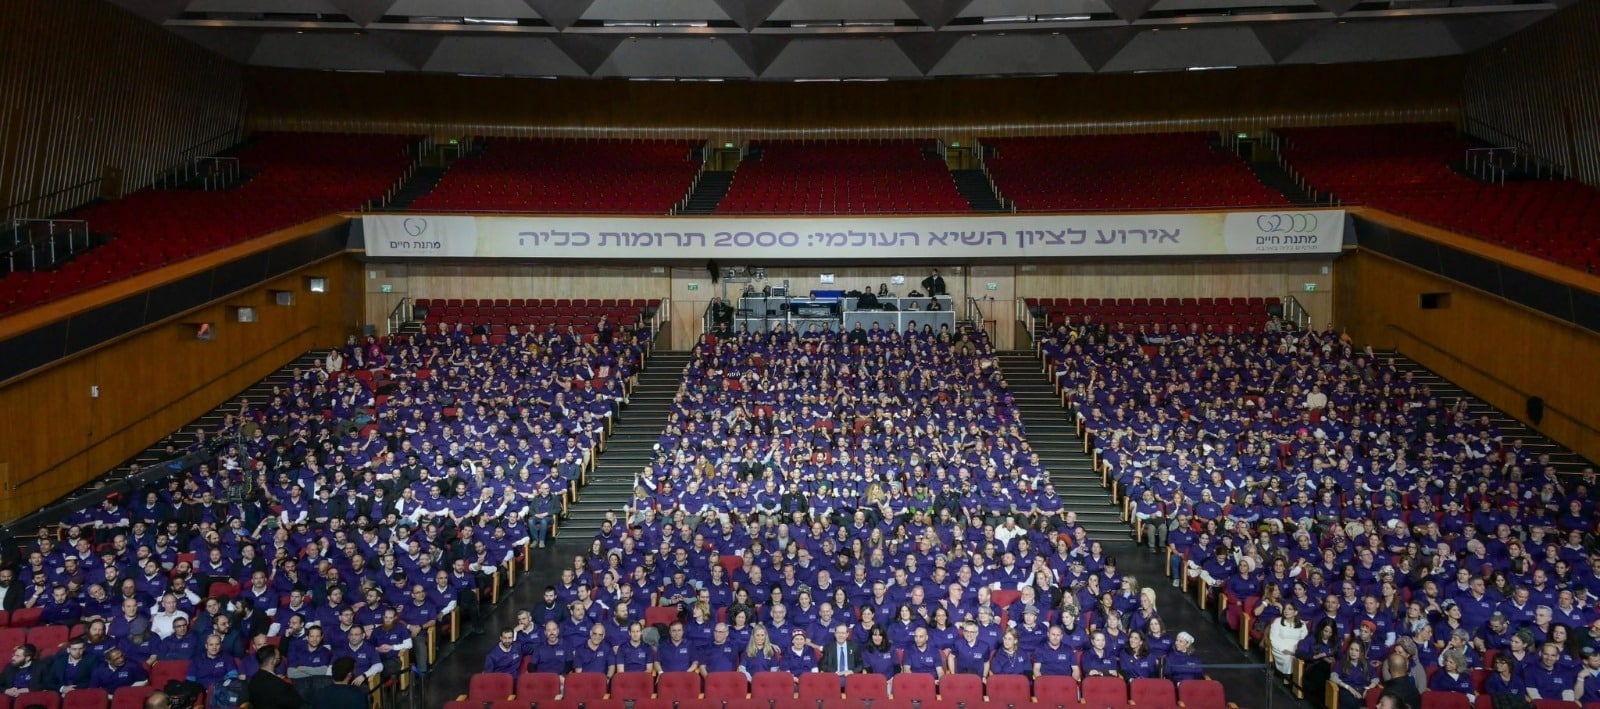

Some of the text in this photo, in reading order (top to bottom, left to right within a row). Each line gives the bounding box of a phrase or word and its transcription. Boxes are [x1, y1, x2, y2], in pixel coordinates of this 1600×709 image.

[518, 227, 1182, 249] אירוע לציון השיא העולמי: 2000 תרומות כליה
[1256, 234, 1318, 245] מתנת חיים
[390, 240, 441, 249] מתנת חיים
